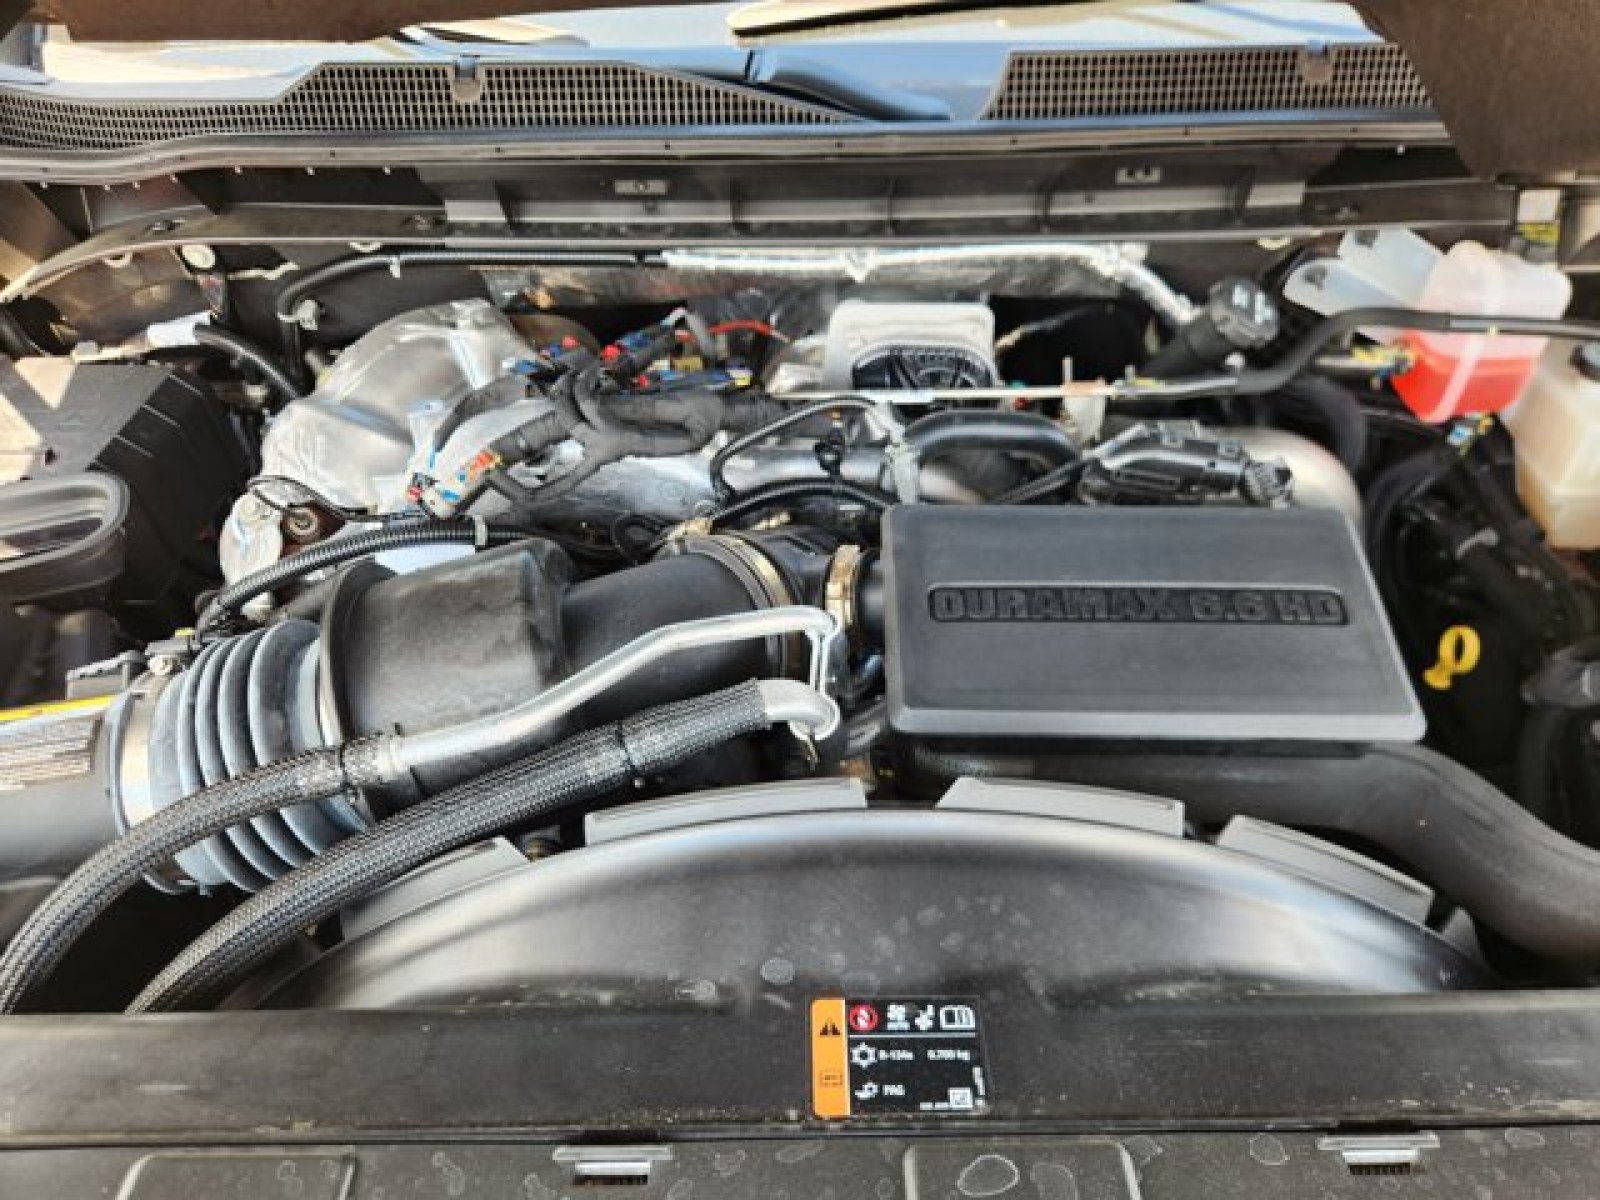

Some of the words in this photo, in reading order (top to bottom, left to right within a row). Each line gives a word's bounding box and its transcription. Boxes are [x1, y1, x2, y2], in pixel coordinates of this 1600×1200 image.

[935, 589, 1177, 620] DURAMAX
[1189, 590, 1266, 621] 6.6
[1276, 591, 1342, 623] HD
